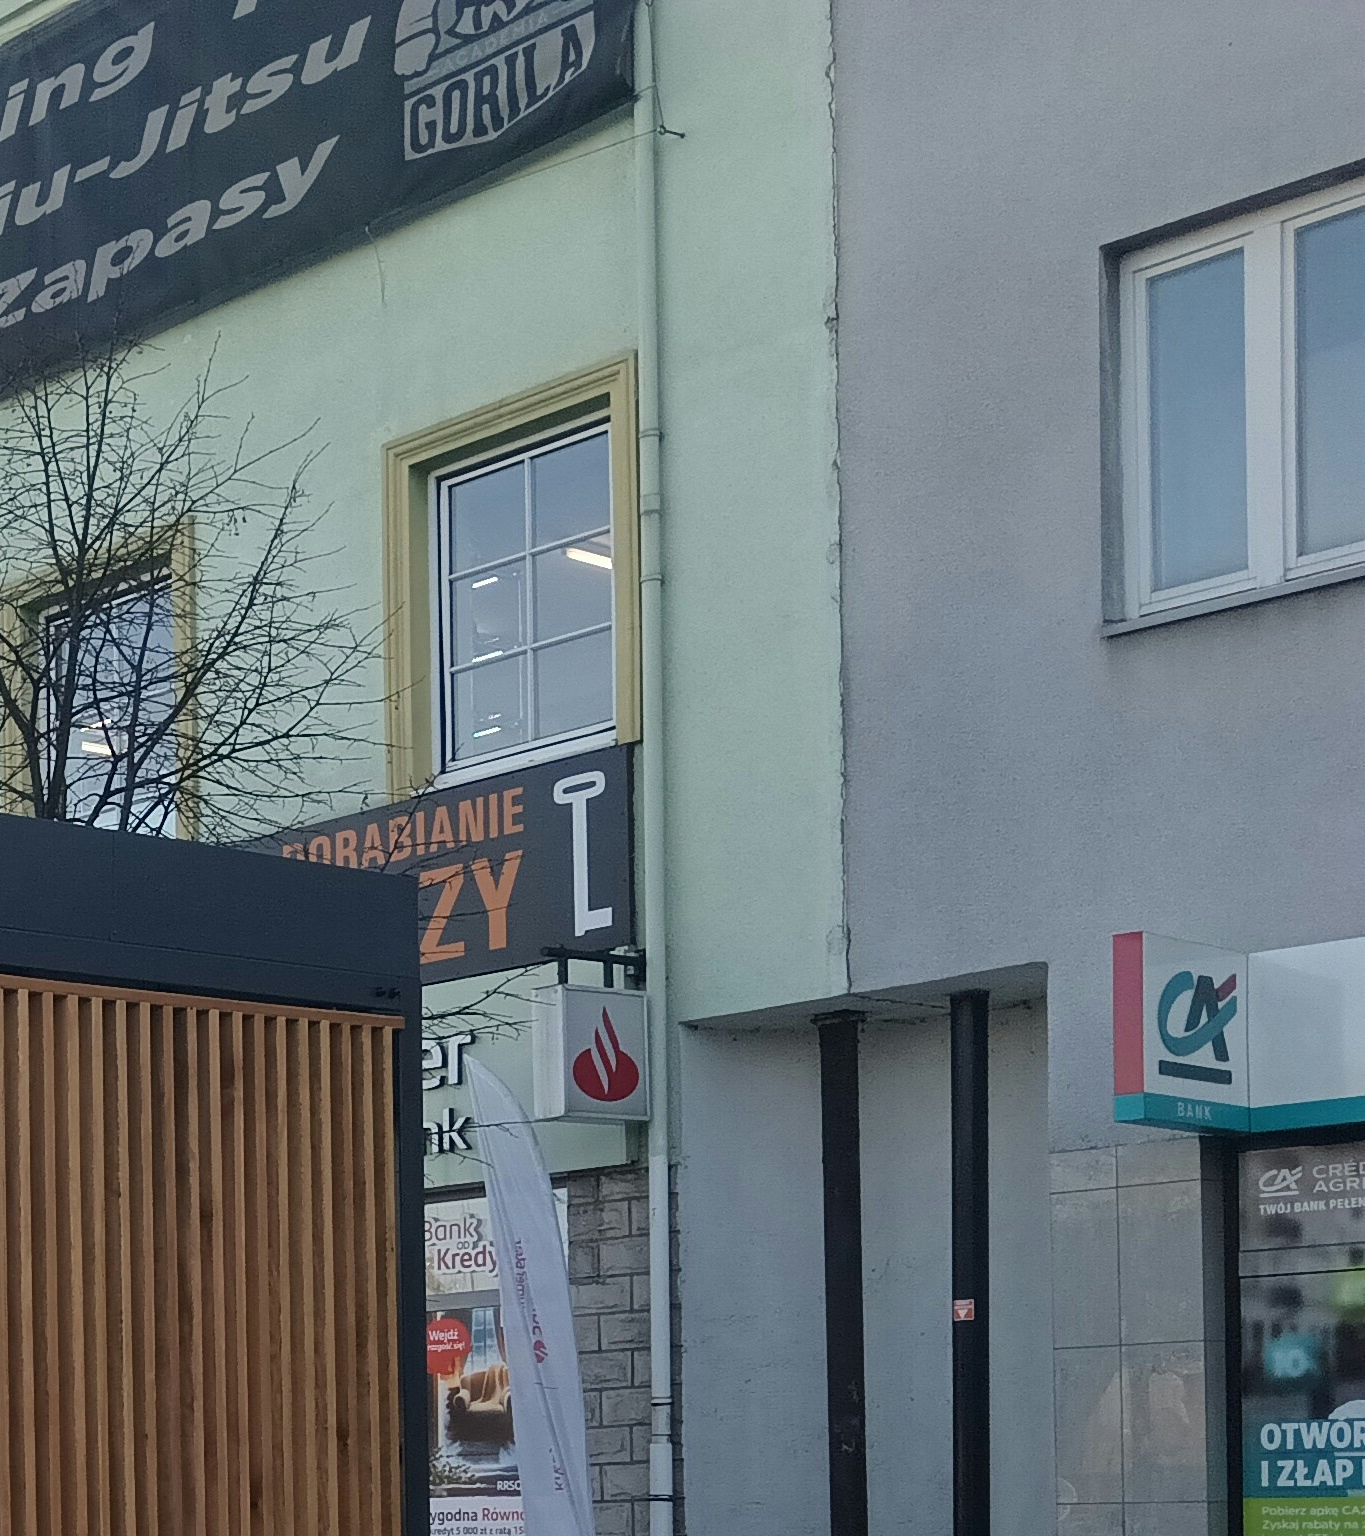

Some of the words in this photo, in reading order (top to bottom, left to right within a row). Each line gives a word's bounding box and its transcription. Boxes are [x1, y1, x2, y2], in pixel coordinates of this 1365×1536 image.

[409, 23, 584, 155] GORILA
[1176, 1101, 1212, 1121] BANK
[1259, 1201, 1291, 1215] TWÓJ
[1294, 1200, 1326, 1213] BANK
[456, 1241, 470, 1250] OD
[428, 1328, 459, 1342] Wejdź
[1260, 1460, 1269, 1487] I
[1277, 1459, 1354, 1487] ZŁAP
[1262, 1506, 1306, 1516] Pobierz
[1262, 1520, 1300, 1530] Zyskaj
[1302, 1519, 1341, 1530] rabaty
